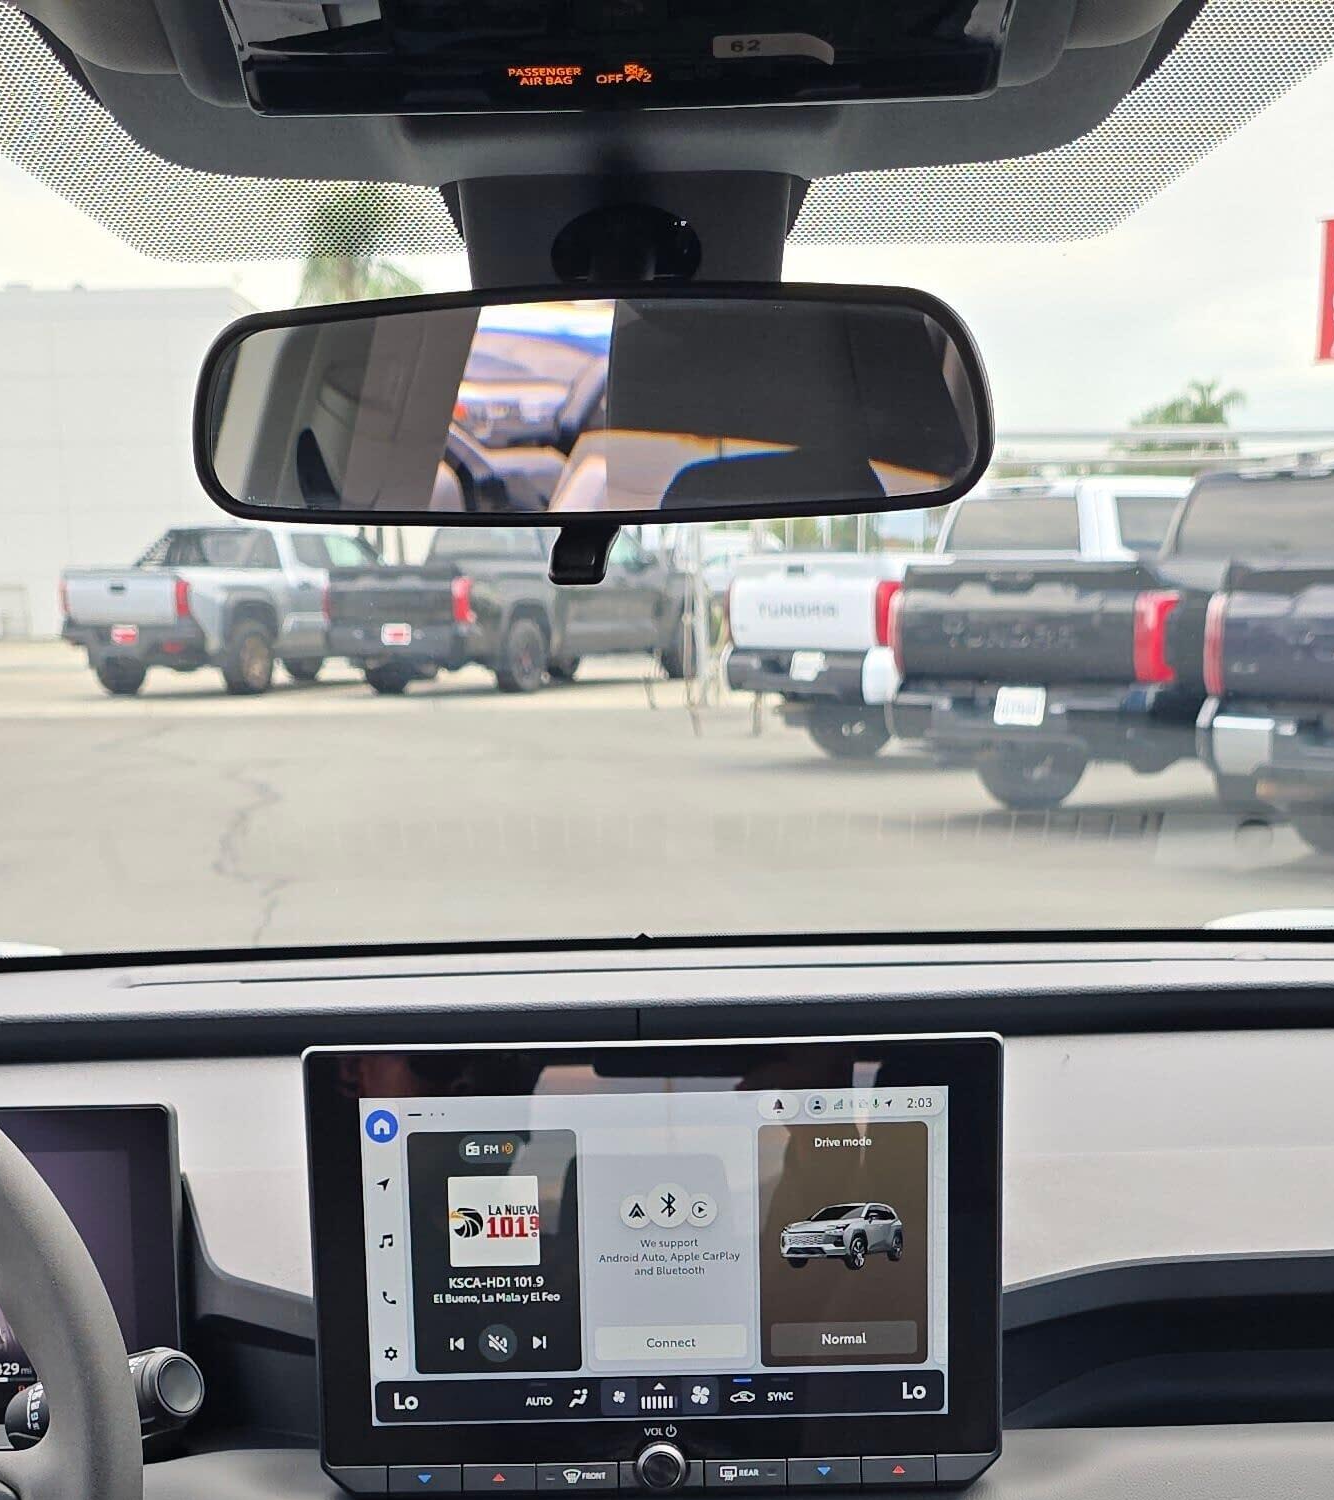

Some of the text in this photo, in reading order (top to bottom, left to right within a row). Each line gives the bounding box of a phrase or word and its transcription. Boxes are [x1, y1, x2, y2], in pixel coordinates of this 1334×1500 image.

[730, 40, 761, 53] 62
[508, 66, 582, 77] PASSENGER
[519, 76, 573, 86] AIR BAG
[596, 74, 624, 84] OFF
[906, 1098, 933, 1109] 2:03
[814, 1136, 873, 1148] Drive mode
[483, 1145, 499, 1154] FM
[640, 1238, 699, 1250] We support
[599, 1251, 741, 1264] Android Auto, Apple CarPlay
[634, 1265, 706, 1276] and Bluetooth
[448, 1276, 545, 1289] KSCA-HD1 101.9
[433, 1292, 561, 1305] El Bueno, La Mala y El Feo
[646, 1337, 697, 1349] Connect
[821, 1332, 867, 1346] Normal
[902, 1381, 927, 1400] Lo
[393, 1392, 419, 1410] Lo
[525, 1396, 554, 1407] AUTO
[767, 1391, 794, 1402] SYNC
[643, 1427, 664, 1437] VOL
[581, 1471, 607, 1481] FRONT
[738, 1468, 760, 1478] REAR
